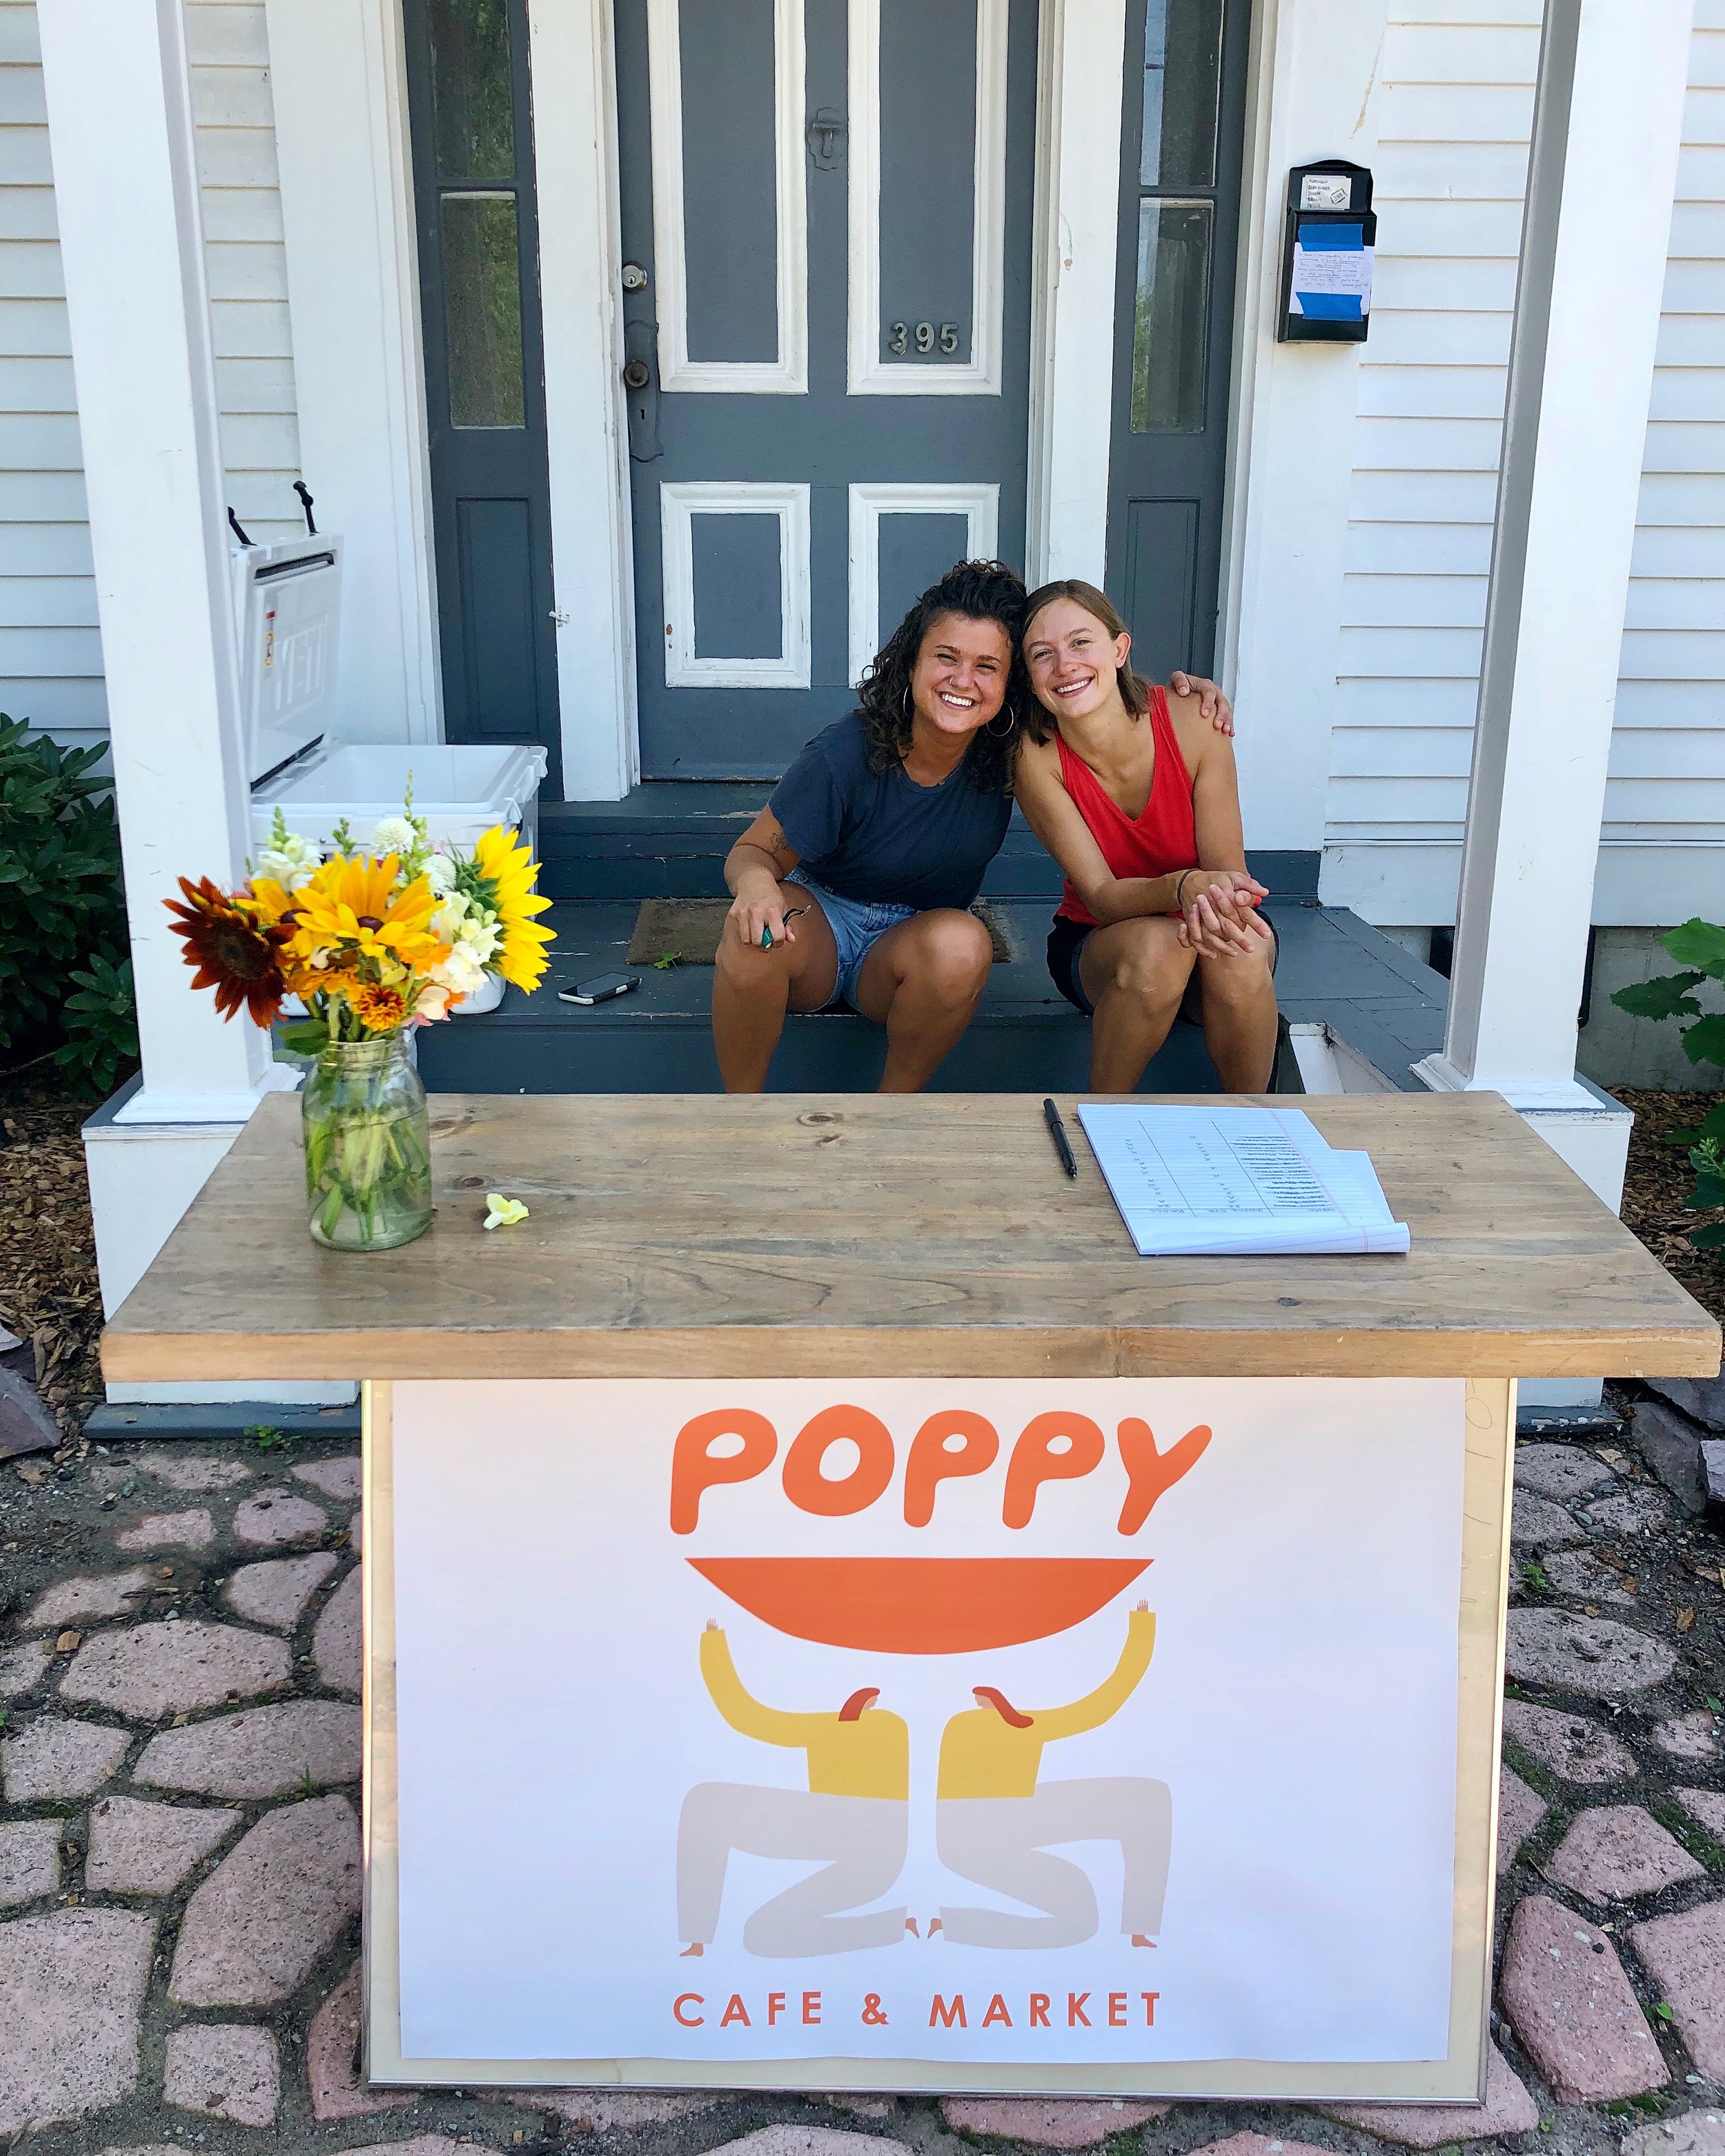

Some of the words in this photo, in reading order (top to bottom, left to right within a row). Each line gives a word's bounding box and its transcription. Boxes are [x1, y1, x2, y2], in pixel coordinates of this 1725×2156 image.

[889, 322, 958, 355] 395
[670, 1404, 1212, 1536] POPPY
[673, 1991, 822, 2027] CAFE
[861, 1992, 890, 2026] &
[928, 1992, 1161, 2028] MARKET
